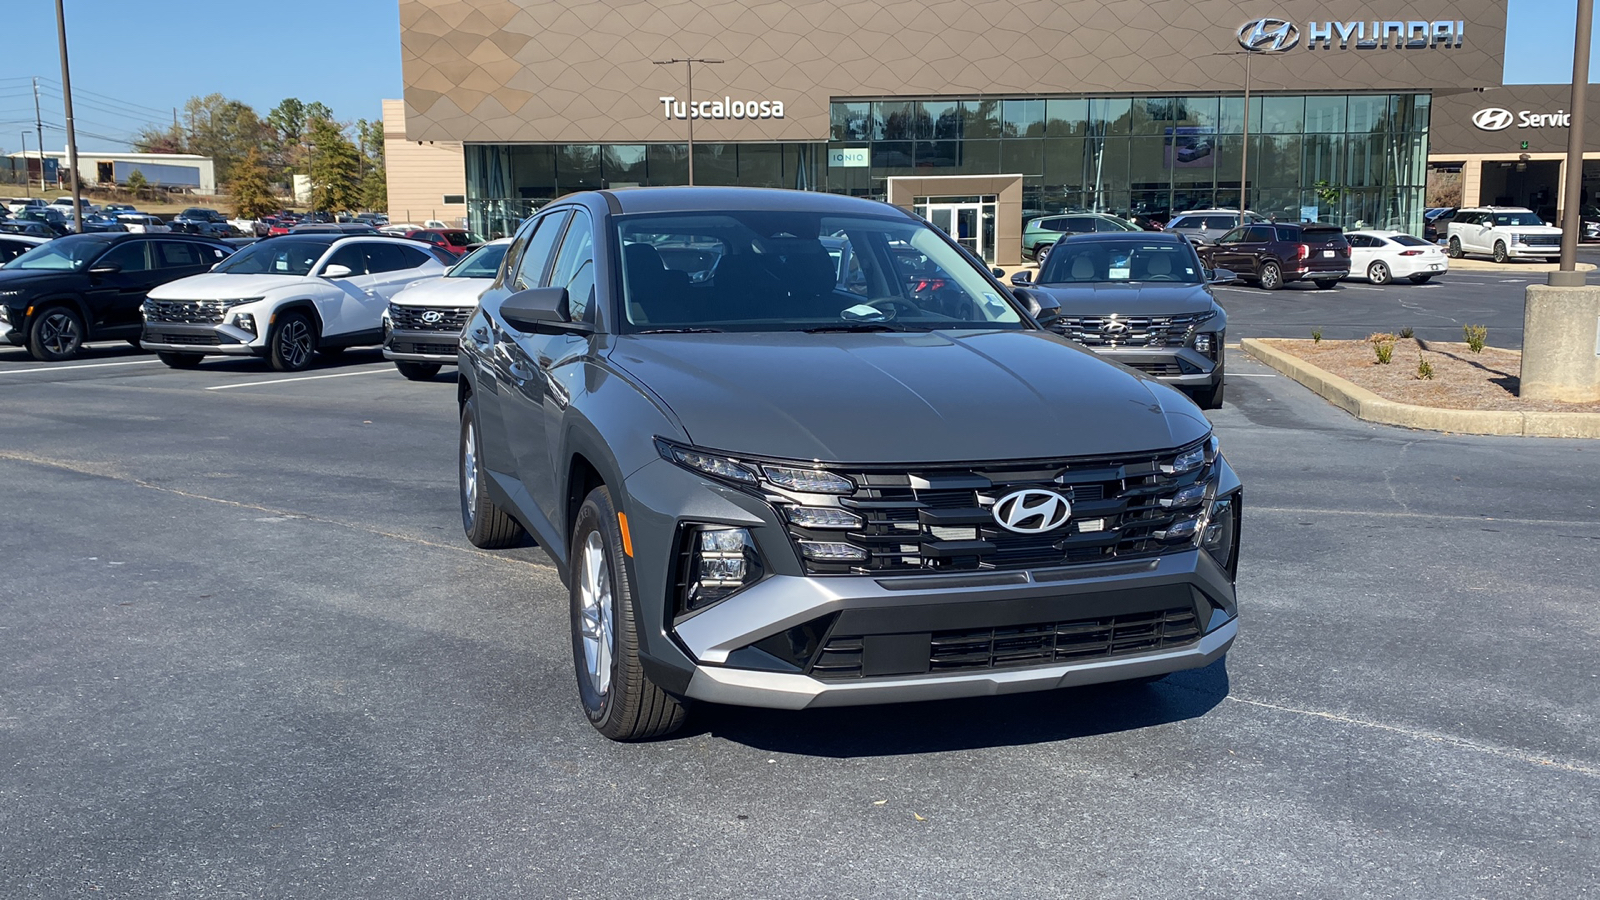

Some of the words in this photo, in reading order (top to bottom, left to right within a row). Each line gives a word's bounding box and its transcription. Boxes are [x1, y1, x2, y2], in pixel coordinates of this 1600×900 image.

[1308, 20, 1464, 50] HYUNDAI
[659, 96, 784, 119] Tuscaloosa
[1517, 109, 1572, 128] Servic
